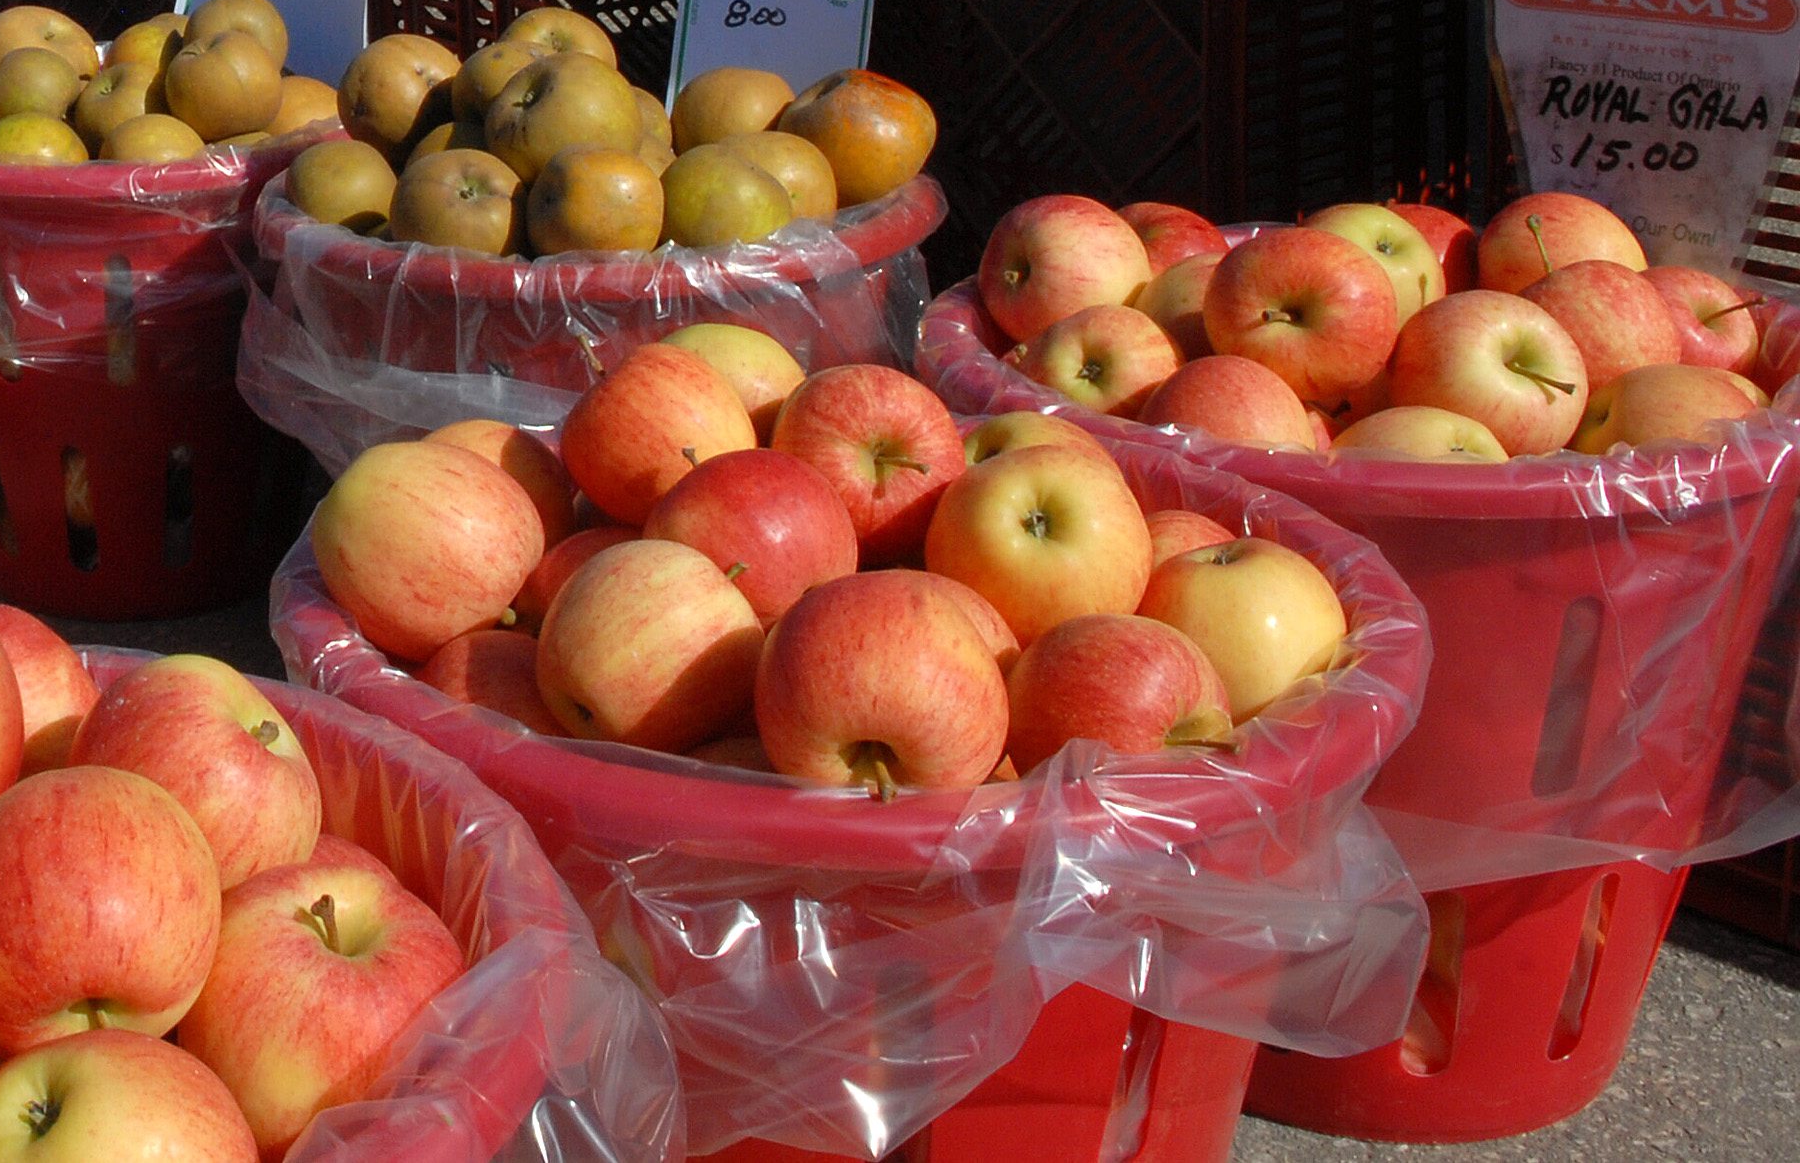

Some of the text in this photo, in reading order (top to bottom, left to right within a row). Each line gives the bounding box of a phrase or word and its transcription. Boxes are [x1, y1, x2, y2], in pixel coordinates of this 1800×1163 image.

[1549, 55, 1588, 76] Fancy
[1611, 63, 1663, 83] Product
[1666, 69, 1686, 85] Of
[1539, 75, 1769, 131] ROYAL GALA
[1570, 133, 1699, 172] 15.00
[1632, 215, 1670, 235] Our
